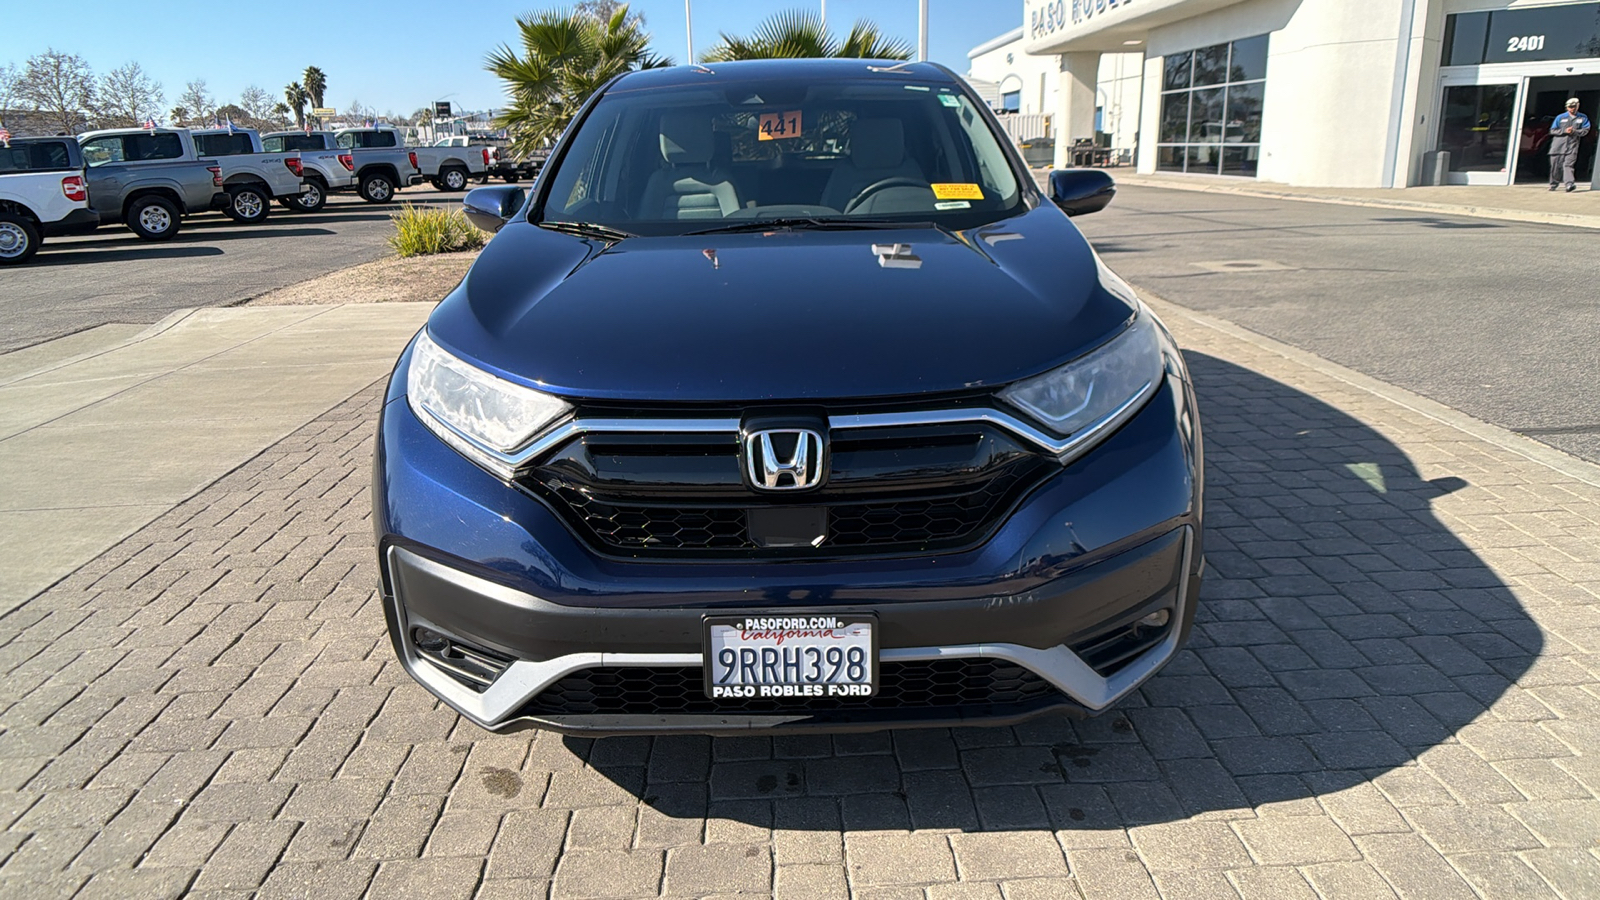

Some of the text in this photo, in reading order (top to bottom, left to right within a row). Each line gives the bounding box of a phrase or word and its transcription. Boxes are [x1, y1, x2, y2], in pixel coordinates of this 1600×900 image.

[1031, 0, 1065, 38] PASO
[1506, 35, 1545, 52] 2401
[760, 117, 797, 136] 441
[745, 617, 837, 630] PASOFORD.COM
[741, 628, 846, 646] California
[718, 646, 866, 684] 9RRH398
[713, 684, 872, 698] PASO ROBLES FORD
